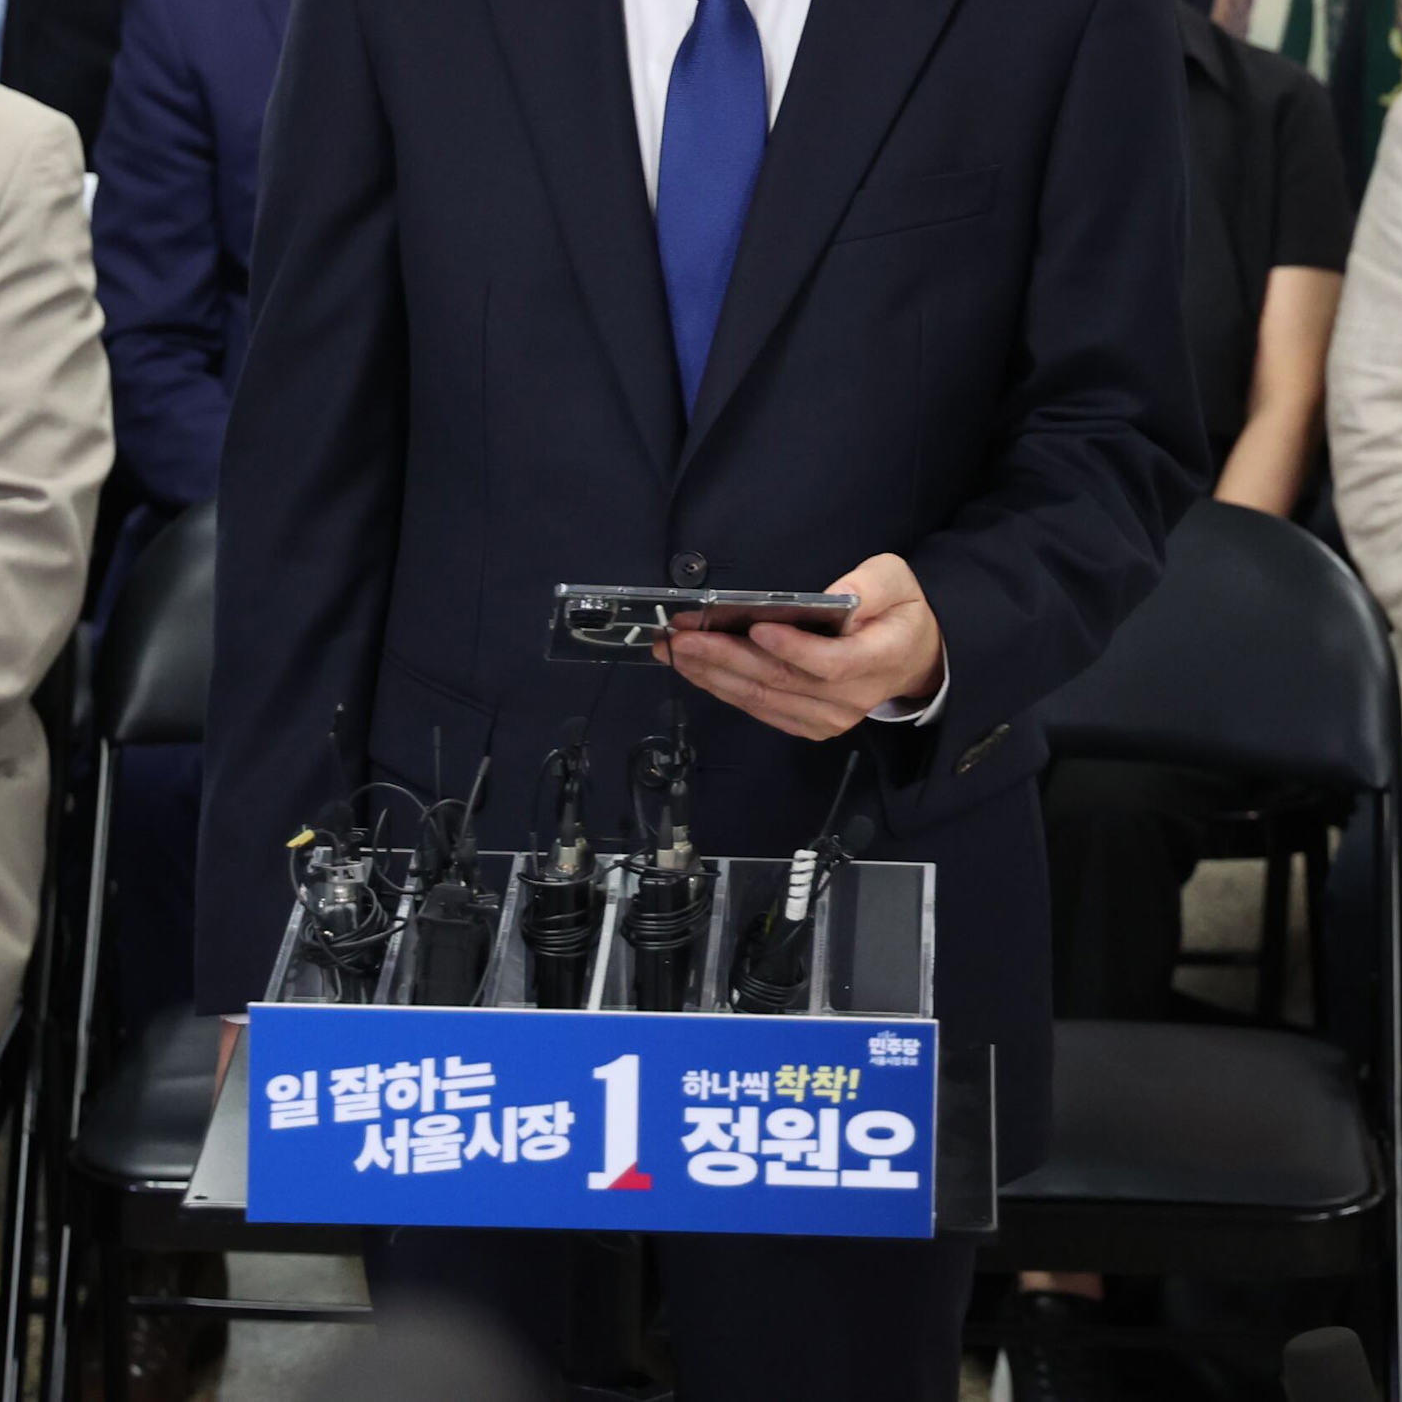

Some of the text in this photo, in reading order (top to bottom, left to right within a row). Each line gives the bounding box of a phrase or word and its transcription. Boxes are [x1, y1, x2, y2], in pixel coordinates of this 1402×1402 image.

[265, 1056, 496, 1130] 일 잘하는
[682, 1064, 860, 1103] 하나씩 착착!
[353, 1101, 575, 1175] 서울시장
[588, 1055, 652, 1190] 1
[681, 1106, 919, 1189] 정원오
